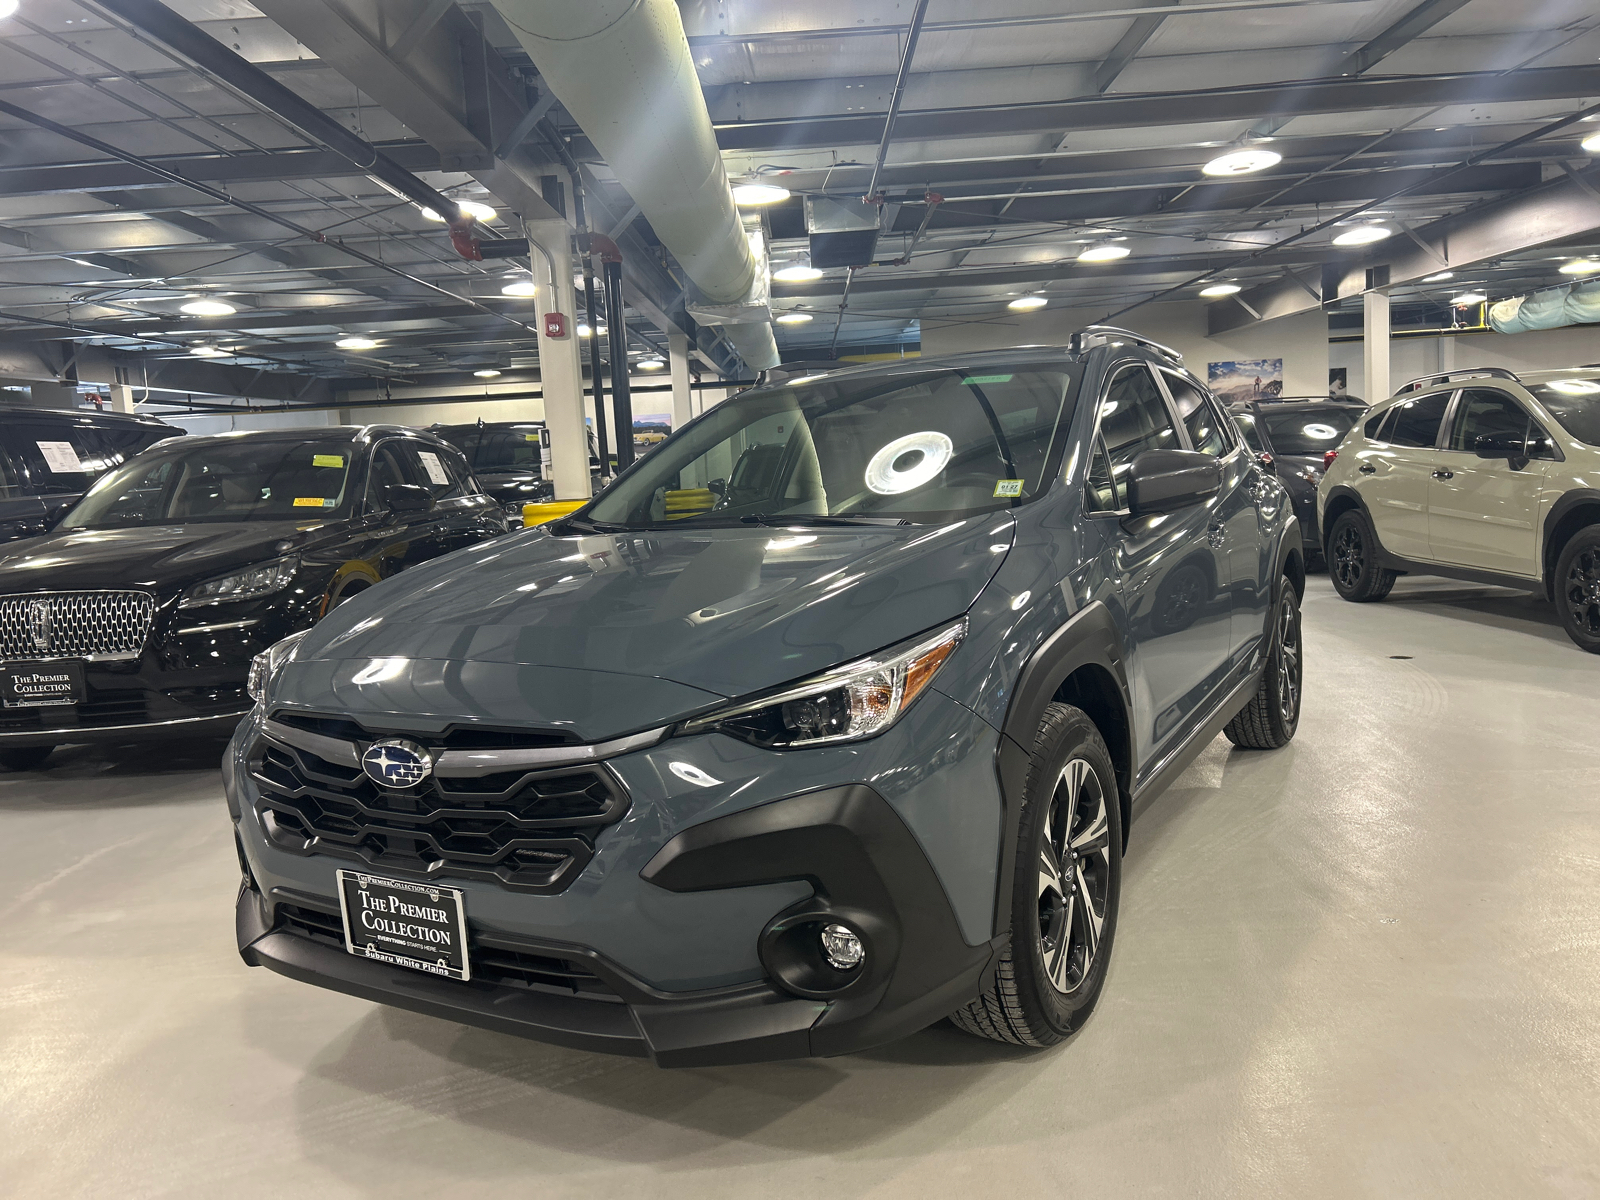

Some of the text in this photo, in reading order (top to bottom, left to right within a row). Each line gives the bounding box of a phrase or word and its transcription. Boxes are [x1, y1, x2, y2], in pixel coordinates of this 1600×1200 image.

[11, 674, 70, 684] THE PREMIER
[14, 684, 71, 693] COLLECTION
[357, 890, 449, 924] THE PREMIER
[361, 910, 451, 946] COLLECTION
[377, 935, 406, 946] EVERYTHING
[406, 940, 424, 951] STARTS
[364, 950, 449, 976] Subaru White Plains
